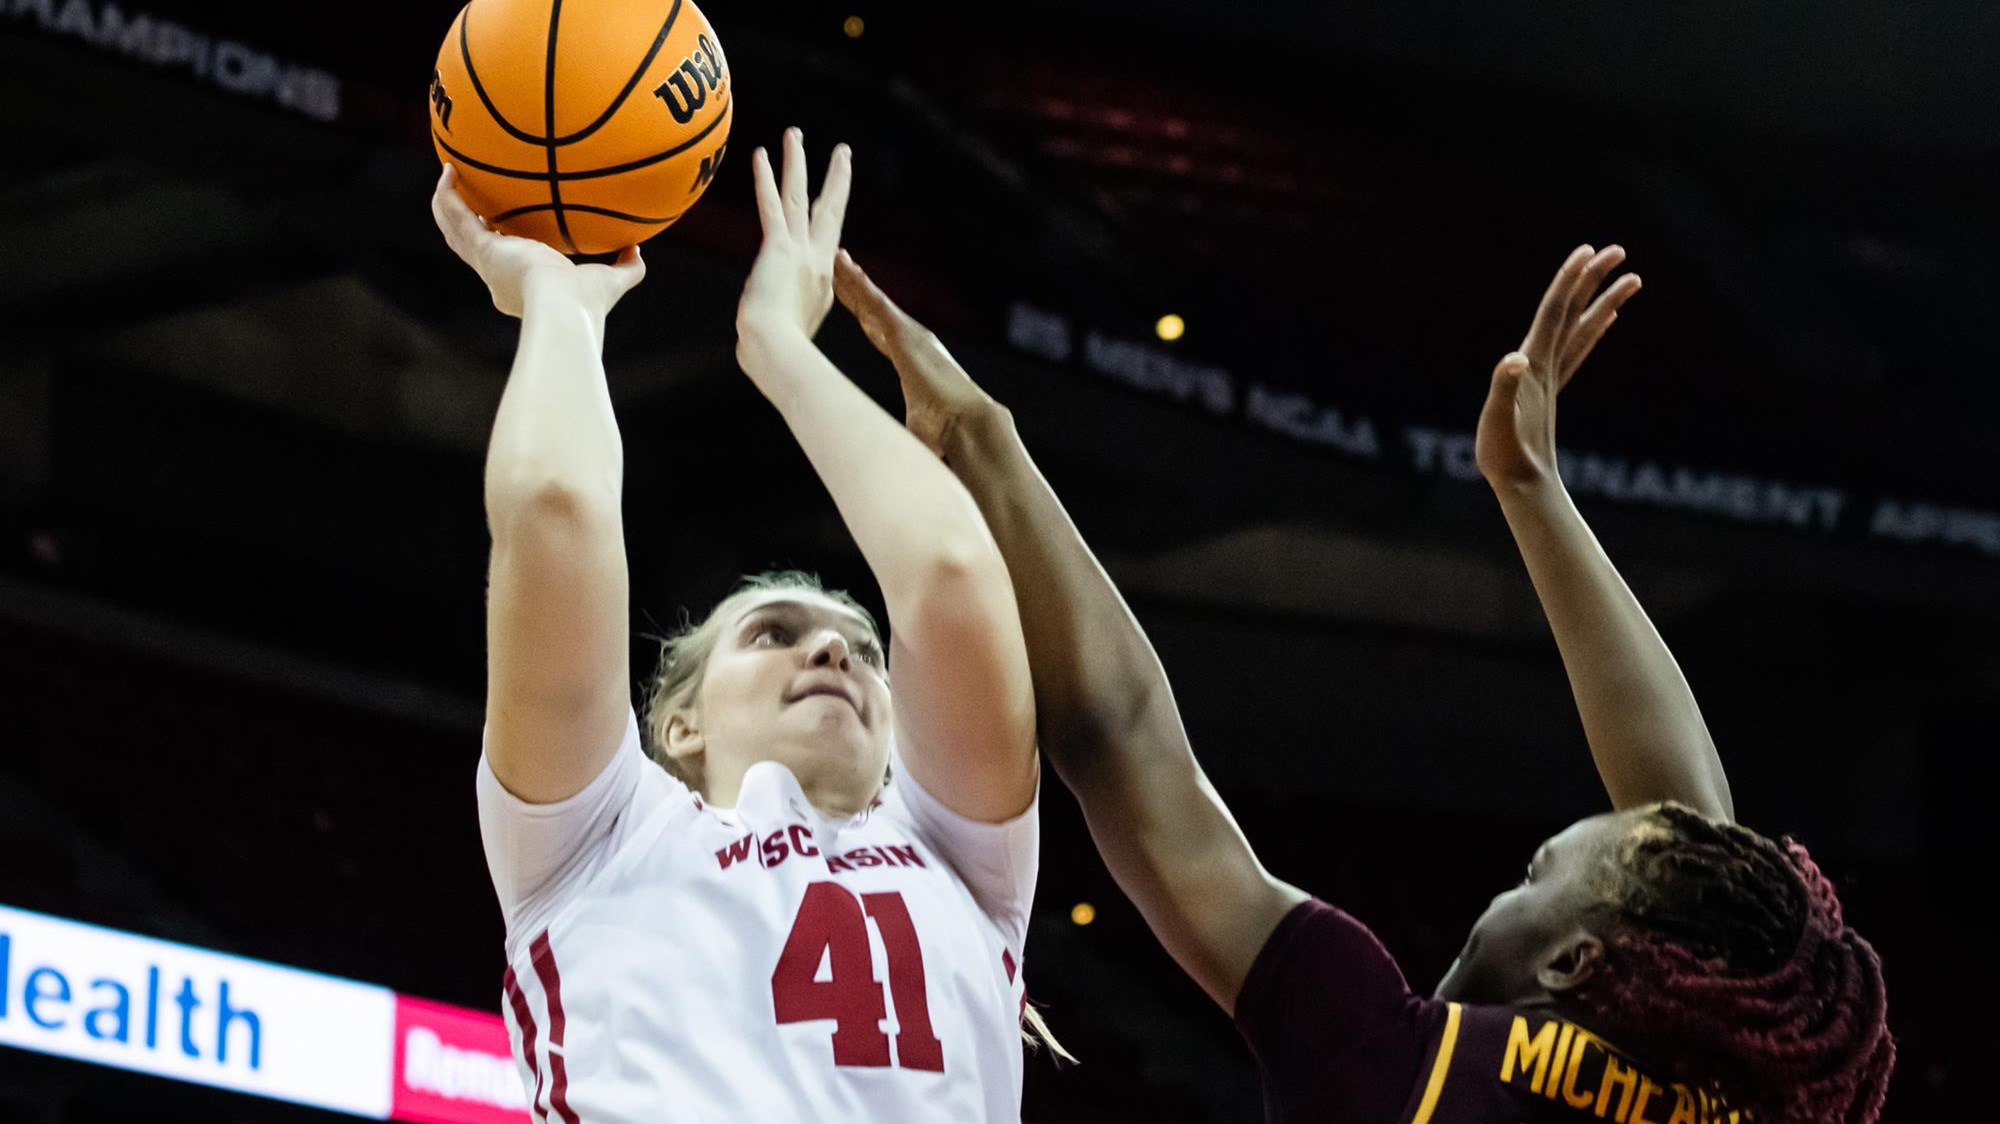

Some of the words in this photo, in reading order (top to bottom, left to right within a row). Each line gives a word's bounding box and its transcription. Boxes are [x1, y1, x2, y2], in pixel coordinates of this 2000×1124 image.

[0, 0, 341, 121] HAMPIONS
[0, 933, 260, 1069] ealth
[771, 881, 945, 1073] 41
